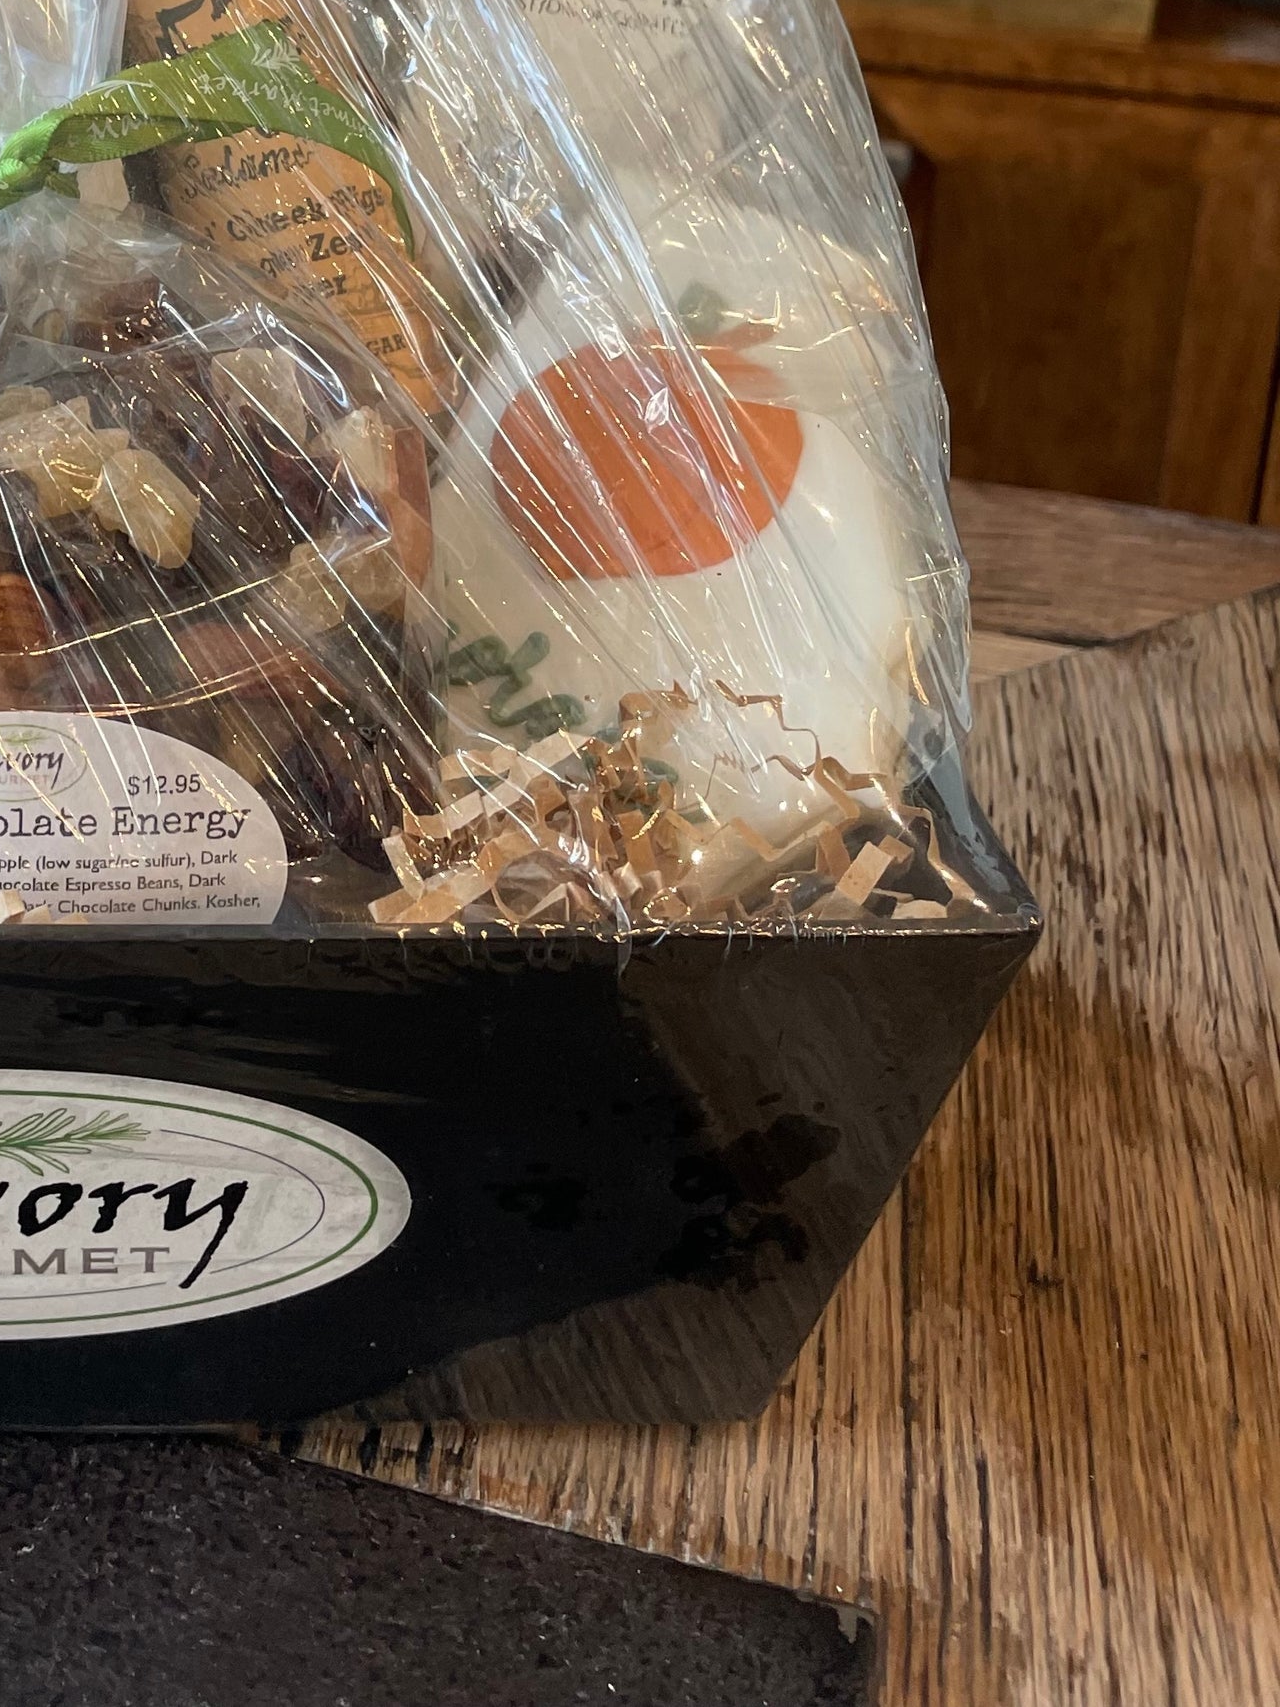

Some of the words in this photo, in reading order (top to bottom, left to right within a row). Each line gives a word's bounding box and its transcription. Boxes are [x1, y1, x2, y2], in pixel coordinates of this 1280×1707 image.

[127, 774, 201, 796] $12.95
[111, 805, 251, 840] Energy
[35, 856, 70, 872] (low
[145, 852, 196, 871] sulfur),
[200, 849, 238, 866] Dark
[64, 876, 132, 895] Espresso
[136, 875, 184, 892] Beans,
[188, 872, 226, 889] Dark
[57, 896, 138, 915] Chocolate
[205, 894, 262, 911] Kosher,
